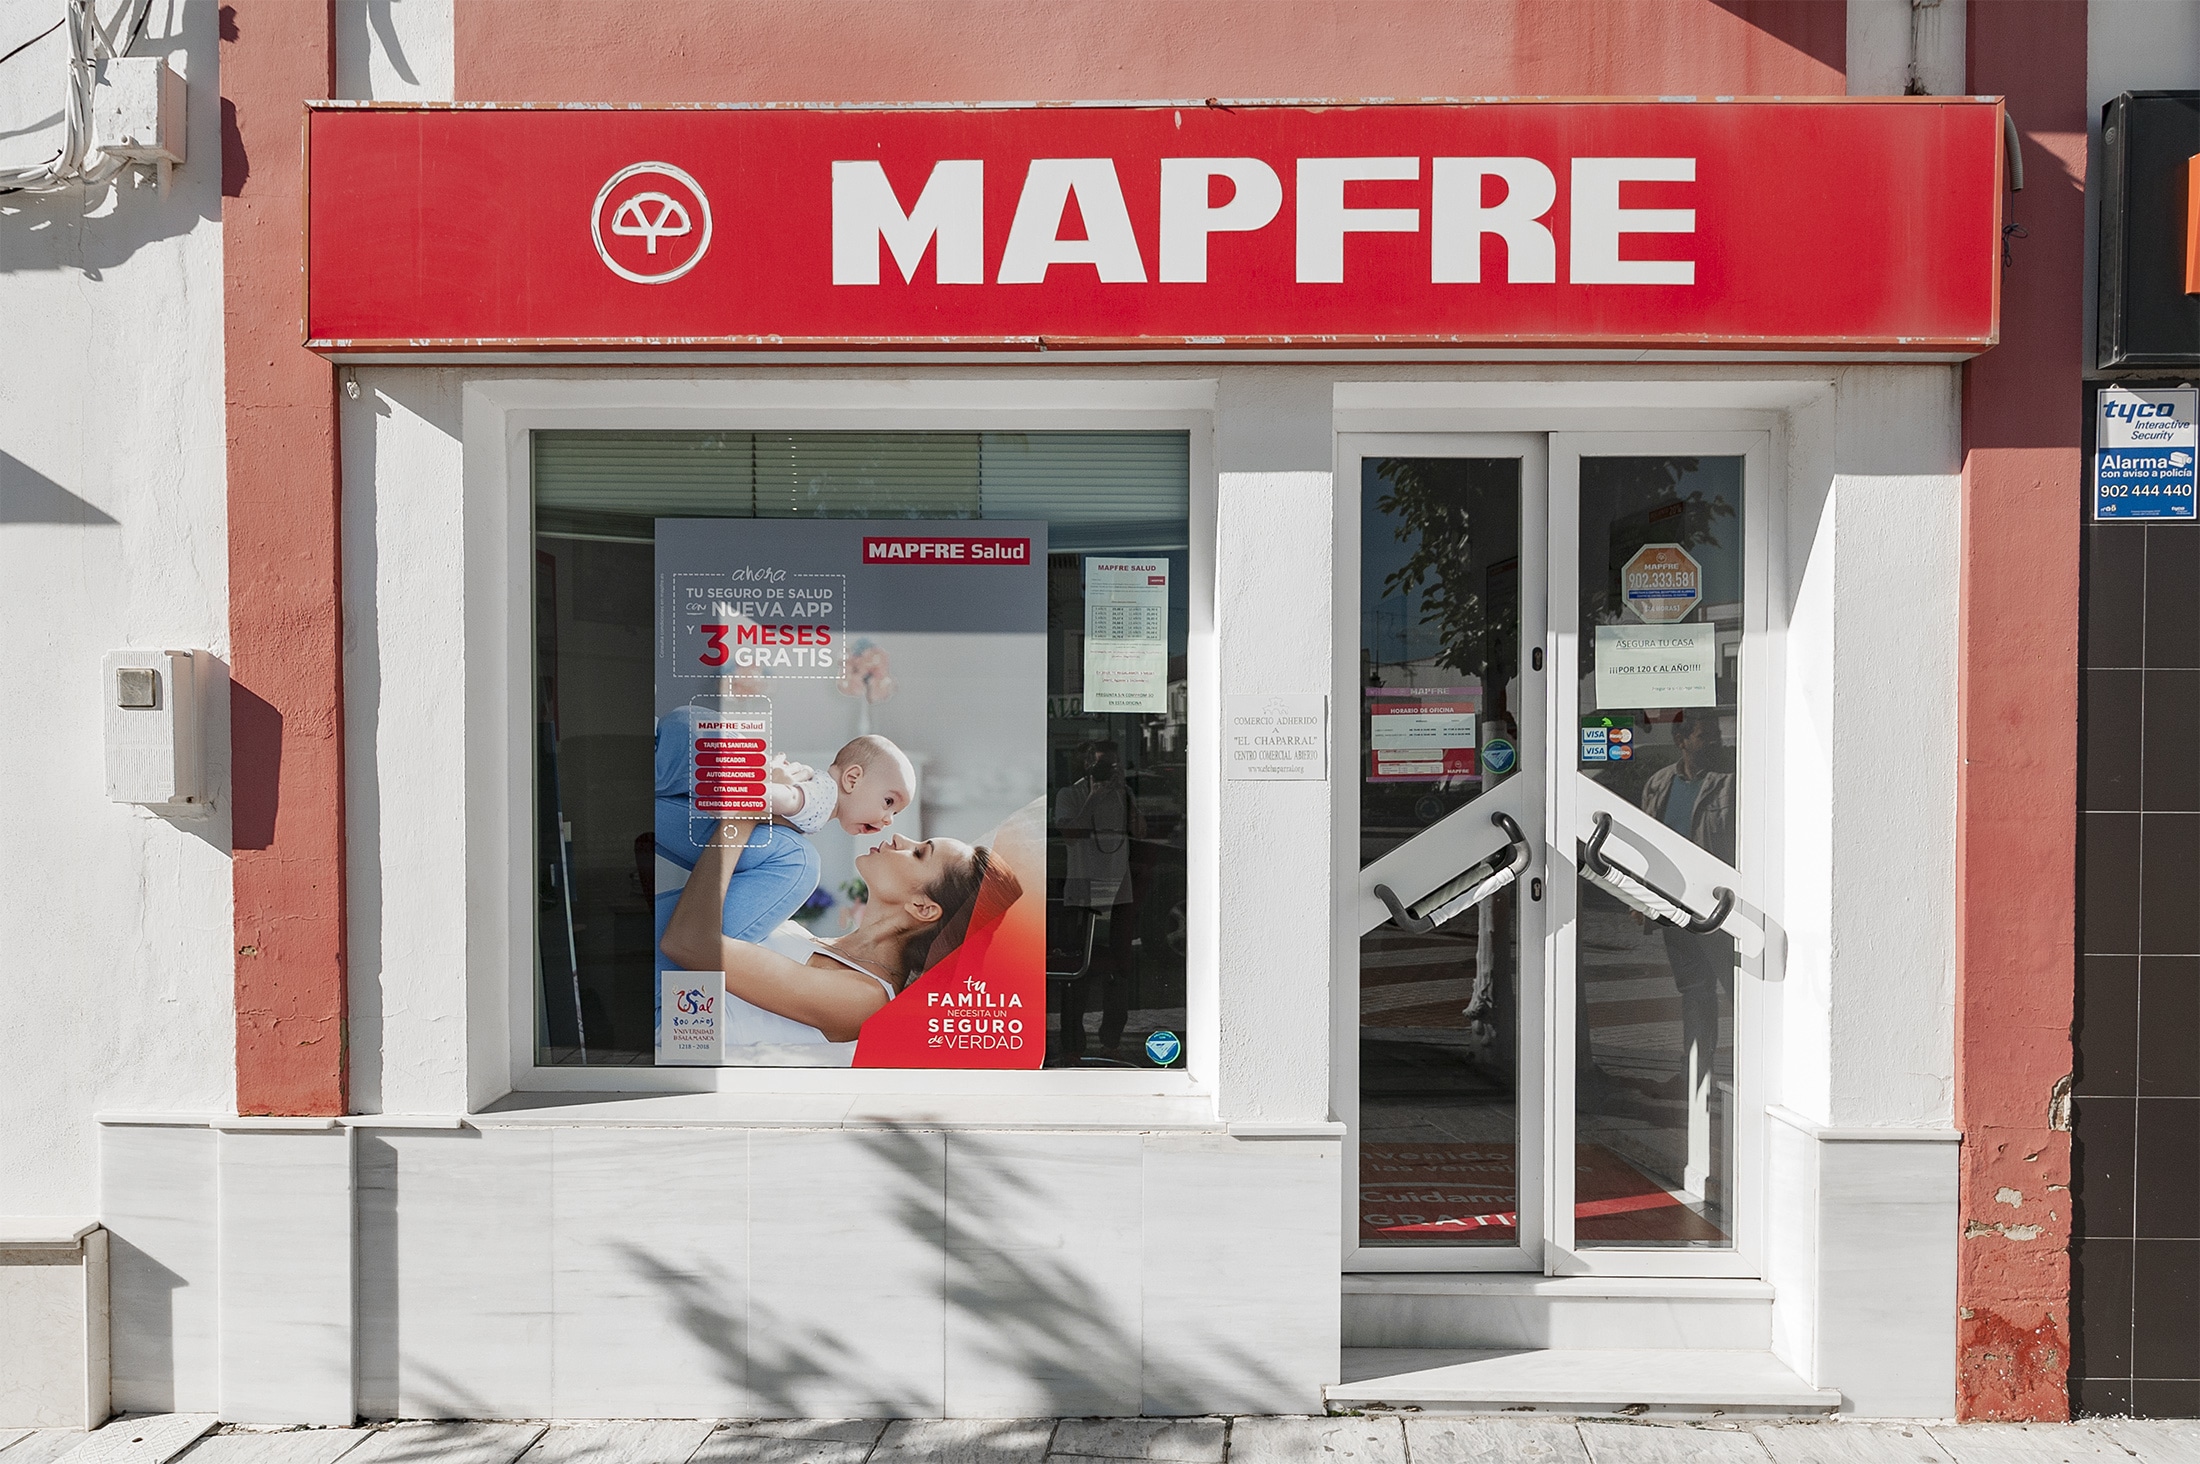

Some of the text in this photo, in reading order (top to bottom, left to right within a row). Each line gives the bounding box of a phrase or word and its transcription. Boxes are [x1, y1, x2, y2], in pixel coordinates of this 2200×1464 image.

[831, 157, 1697, 285] MAPFRE
[2103, 400, 2175, 423] tyco
[2134, 420, 2190, 430] Interactive
[2131, 430, 2174, 441] Security
[2101, 455, 2167, 469] Alarma
[2101, 470, 2120, 478] con
[2122, 468, 2149, 478] aviso
[2160, 468, 2192, 479] policía
[2101, 484, 2192, 498] 902 444 440
[868, 543, 1024, 559] MAPFRE Salud
[731, 565, 787, 583] ahora
[1097, 564, 1129, 572] MAPFRE
[1628, 571, 1695, 588] 902.333.581
[686, 588, 833, 599] TU SEGURO DE SALUD
[685, 601, 833, 618] con NUEVA APP
[686, 624, 832, 667] Y 3 MESES
[1616, 638, 1694, 648] ASEGURA TU CASA
[734, 647, 833, 667] GRATIS
[1637, 665, 1651, 673] 120
[1410, 687, 1449, 695] MAPFRE
[741, 722, 763, 730] Salud
[1234, 716, 1318, 725] COMERCIO ADHERIDO
[1254, 736, 1318, 746] CHAPARRAL"
[1586, 730, 1605, 738] VISA
[1234, 750, 1318, 760] CENTRO COMERCIAL ABIERTO
[963, 975, 987, 994] tu
[927, 993, 1023, 1008] FAMILIA
[947, 1009, 1007, 1018] NECESITA UN
[928, 1018, 1023, 1034] SEGURO
[928, 1035, 1024, 1050] de VERDAD
[1363, 1213, 1516, 1227] GRATI
